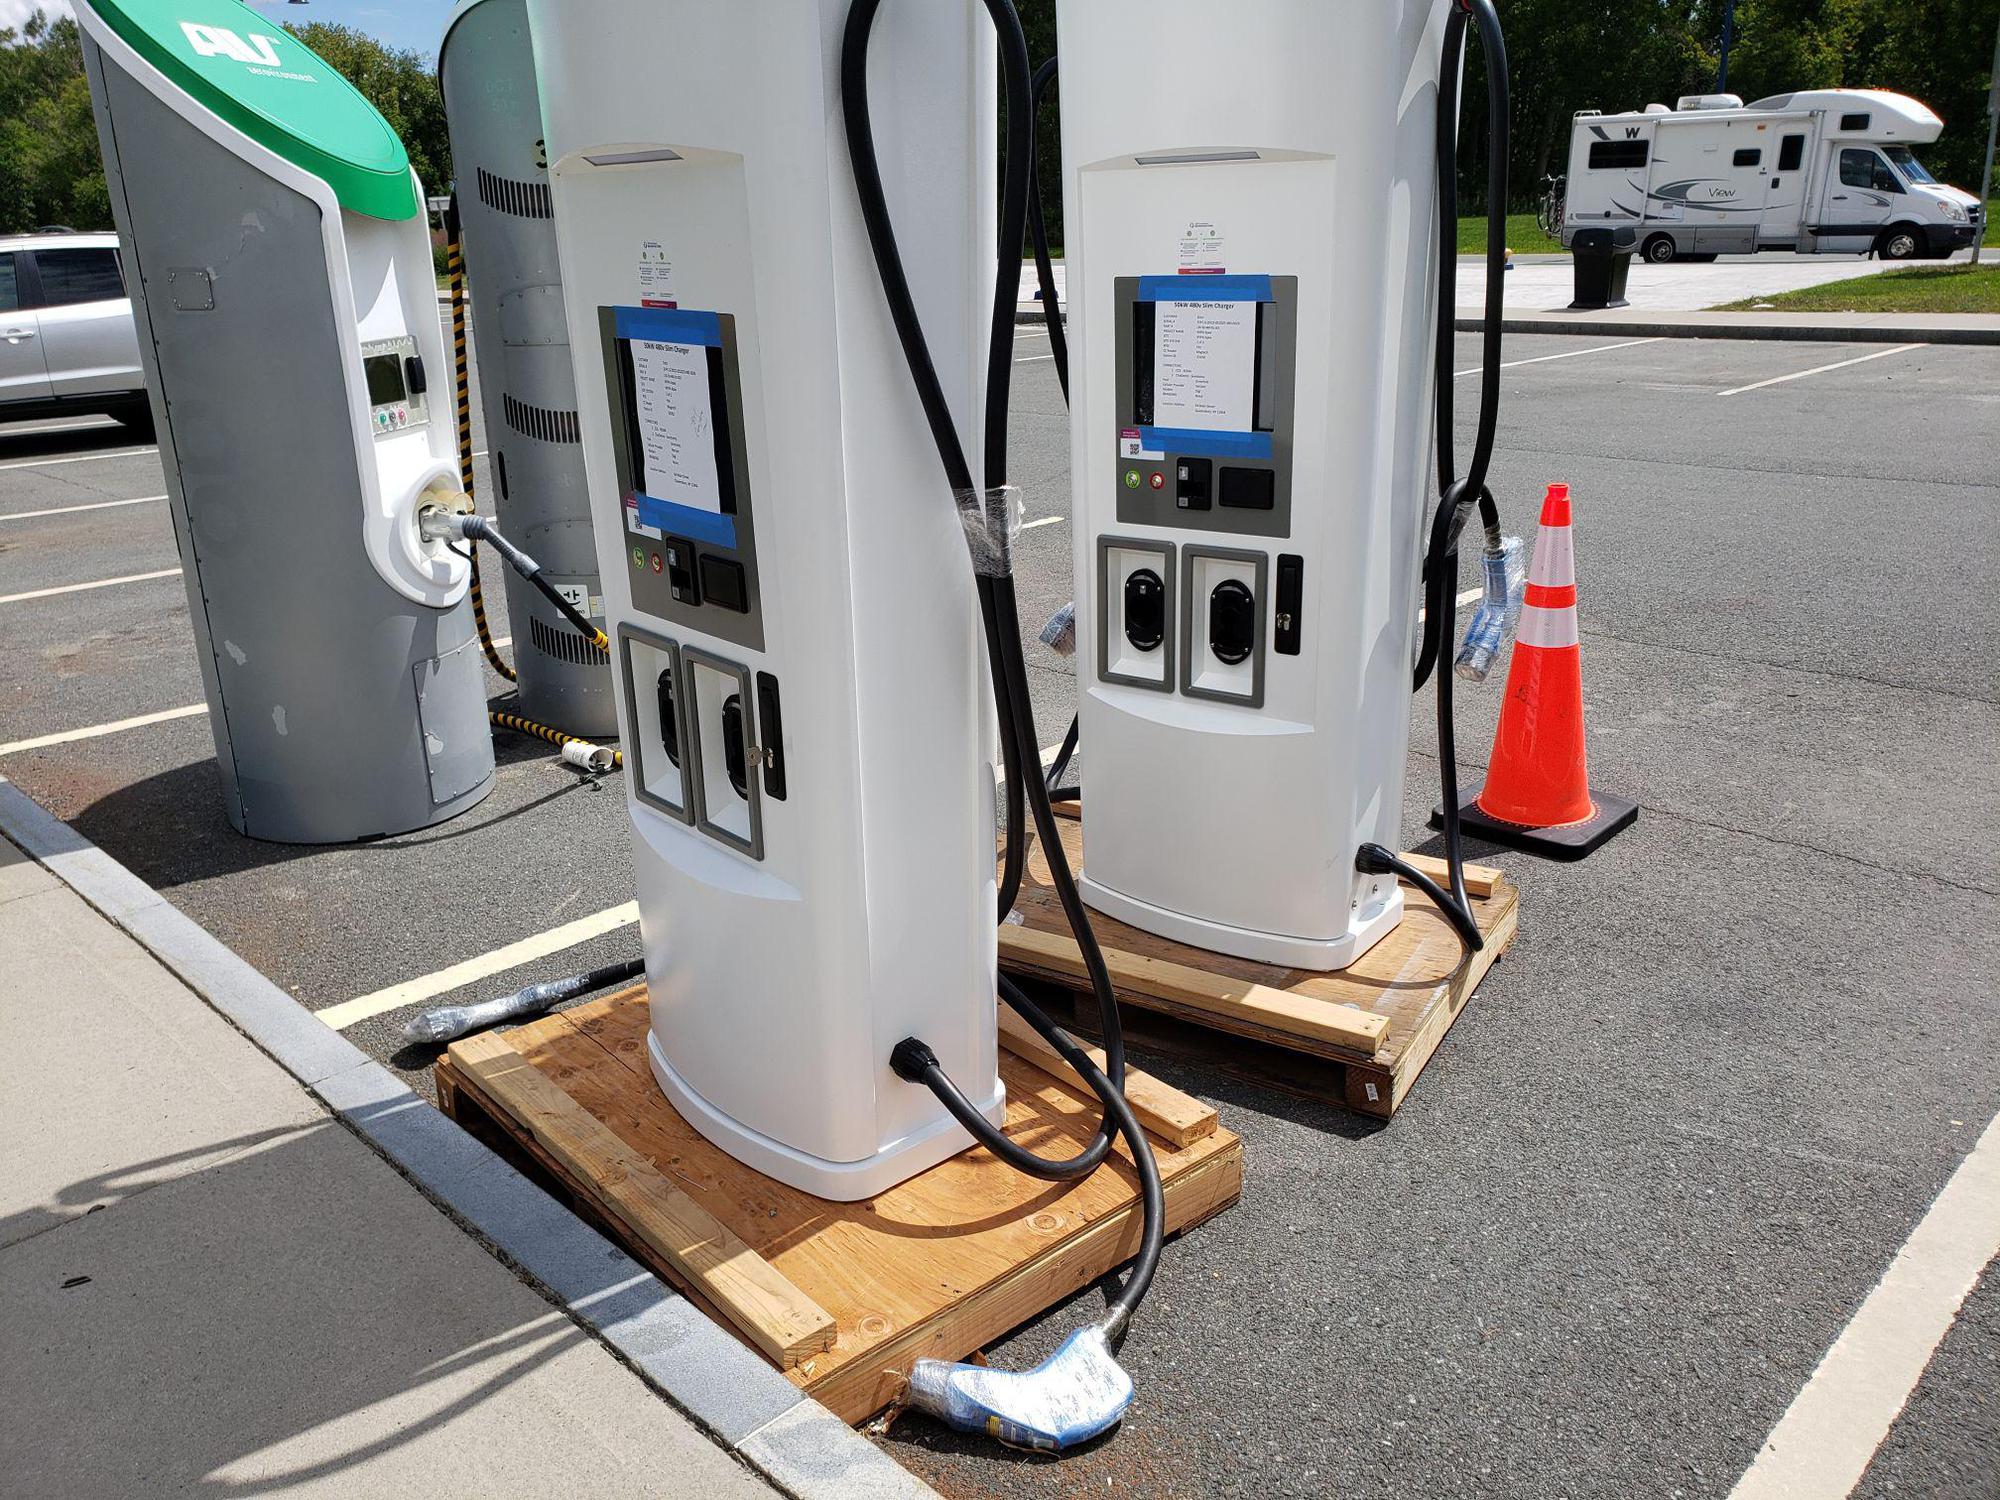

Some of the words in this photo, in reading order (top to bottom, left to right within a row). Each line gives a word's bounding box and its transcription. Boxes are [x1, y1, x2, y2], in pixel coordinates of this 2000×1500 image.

[179, 21, 281, 67] AV
[1624, 126, 1640, 139] W
[1708, 187, 1736, 198] View
